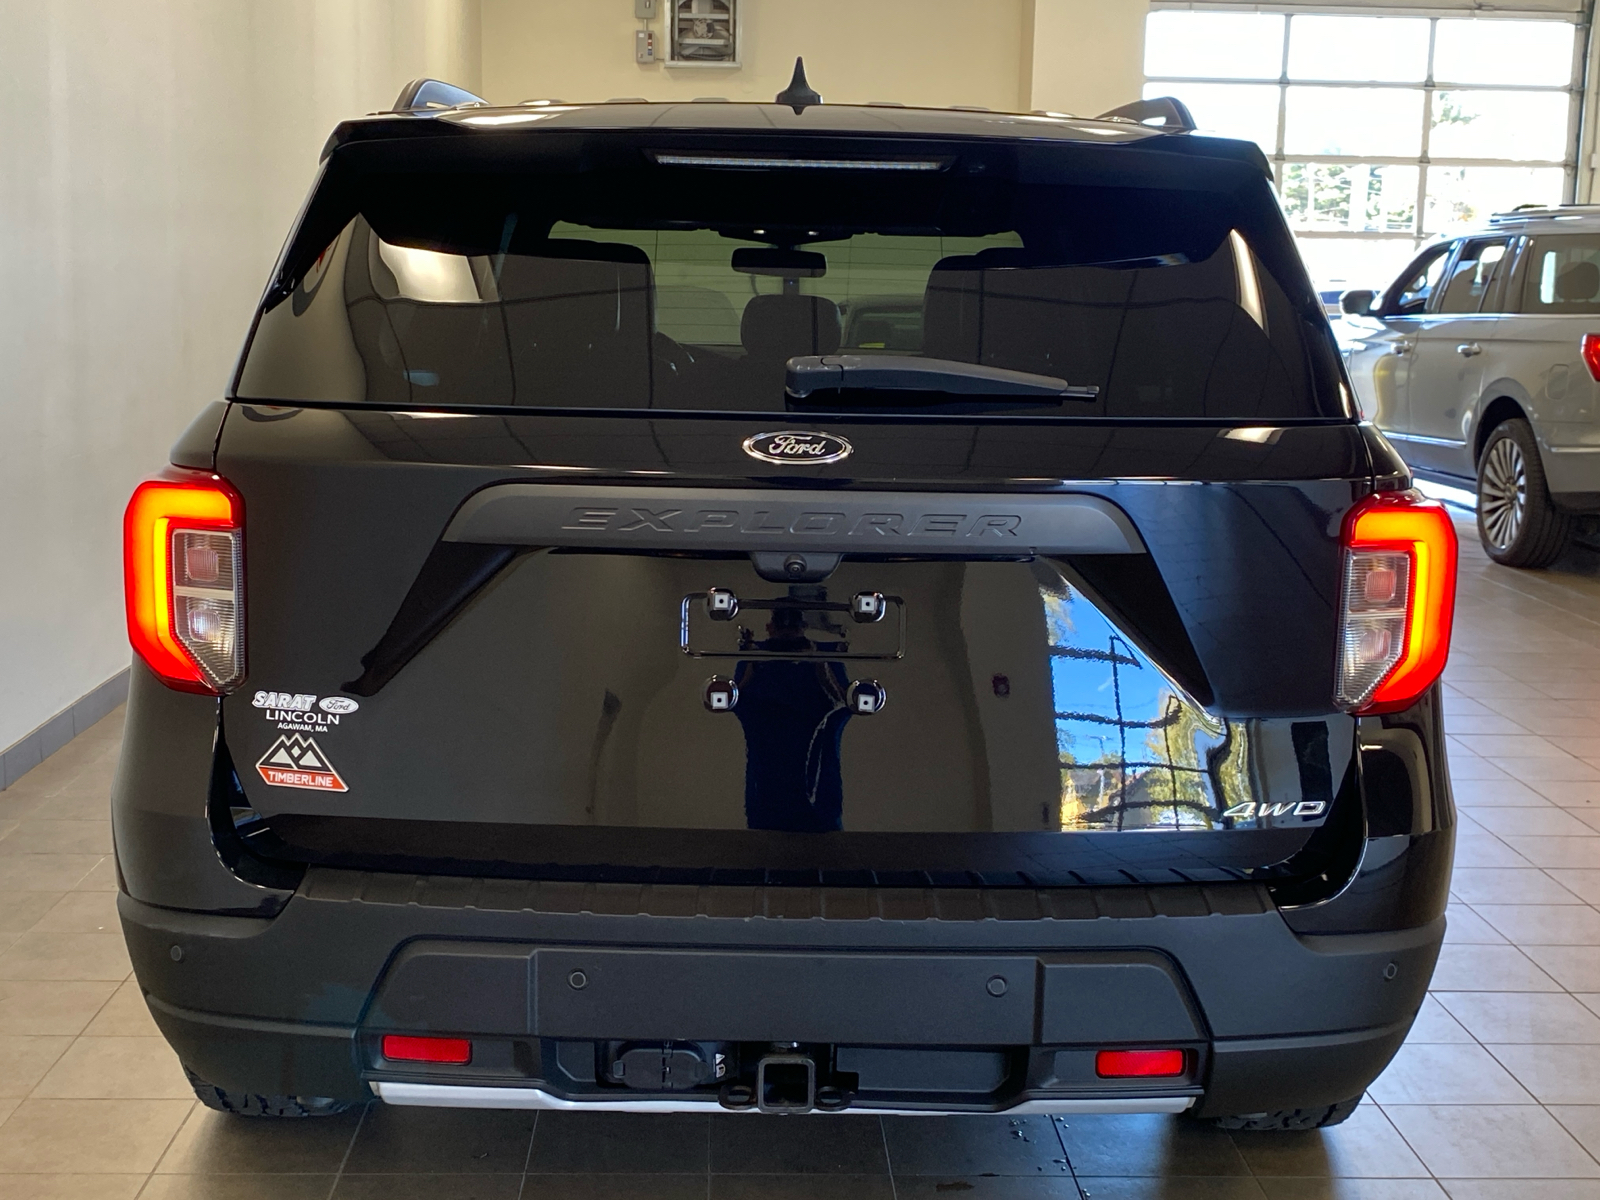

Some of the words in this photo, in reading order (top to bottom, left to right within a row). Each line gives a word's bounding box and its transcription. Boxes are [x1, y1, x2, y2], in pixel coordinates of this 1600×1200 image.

[768, 434, 826, 455] Ford
[561, 507, 1022, 537] EXPLORER
[252, 690, 317, 711] SARAT
[265, 709, 340, 725] LINCOLN
[277, 722, 314, 732] AGAWAM,
[267, 771, 334, 787] TIMBERLINE
[1223, 800, 1327, 818] 4WD
